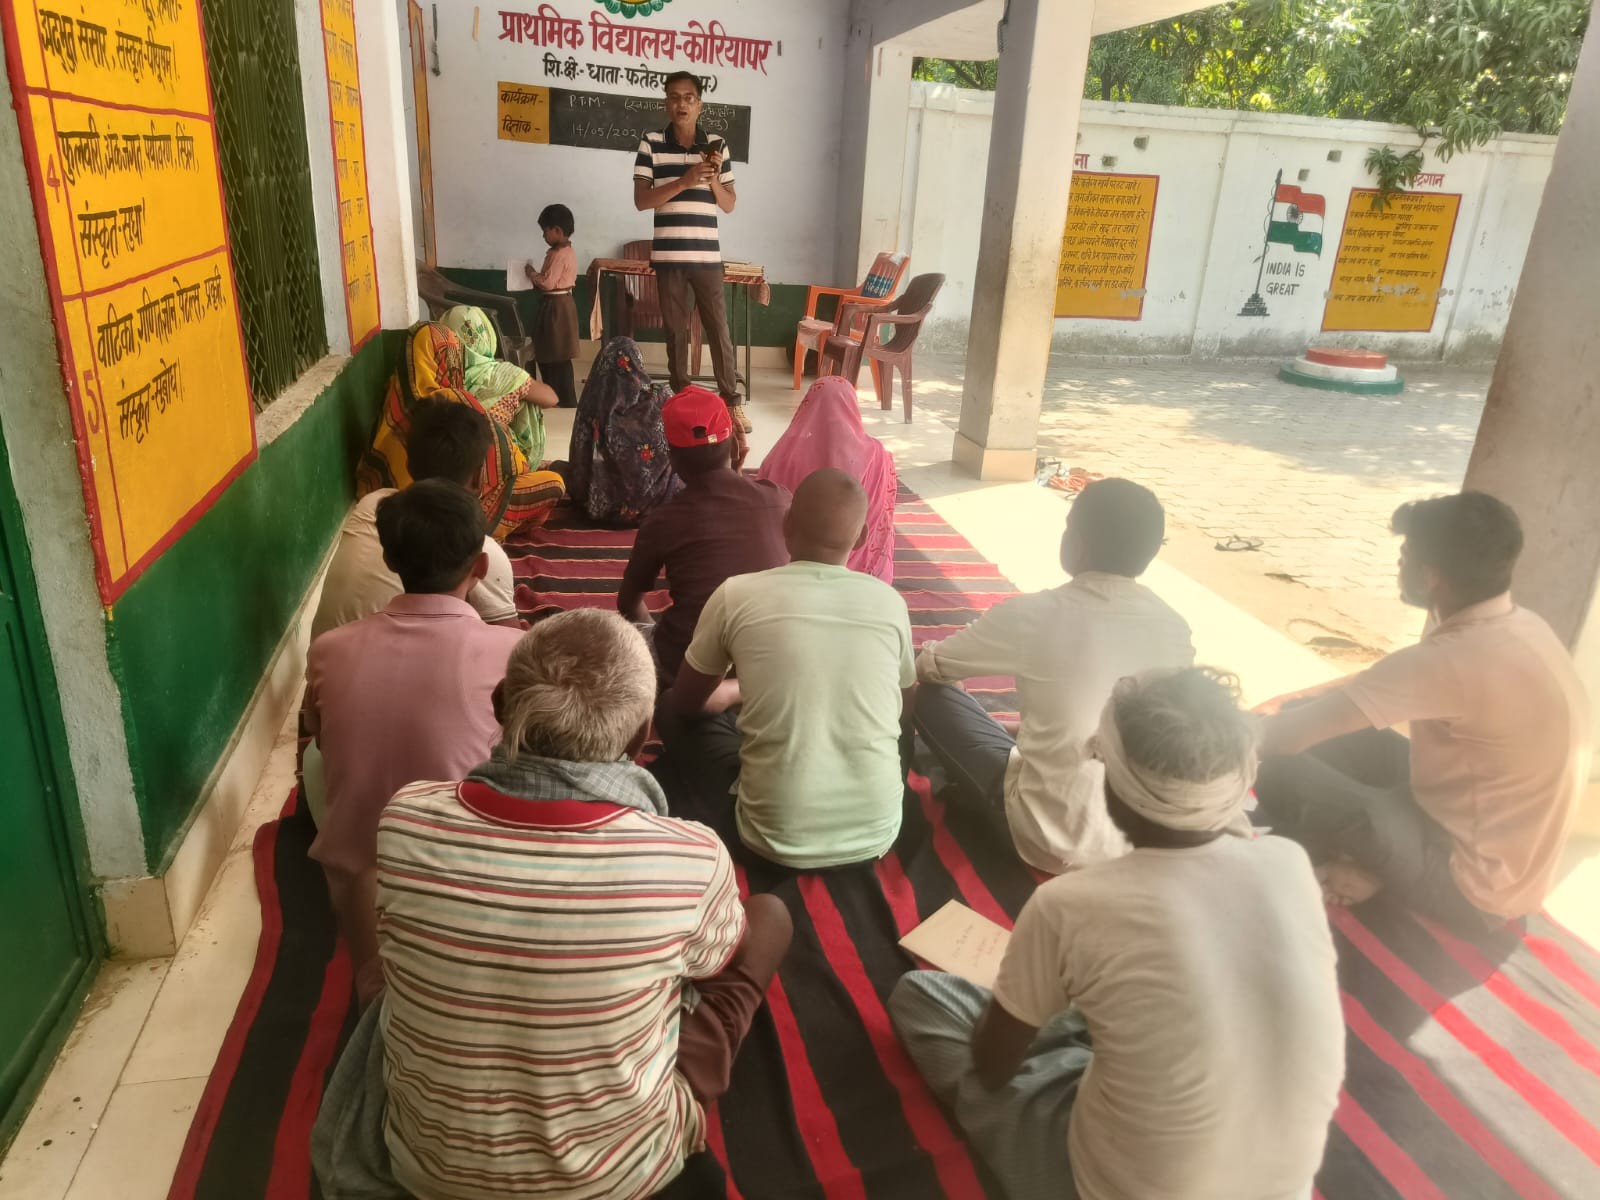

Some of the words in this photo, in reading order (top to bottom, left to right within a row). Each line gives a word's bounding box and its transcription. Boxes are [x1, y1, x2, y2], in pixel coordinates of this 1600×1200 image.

[498, 4, 584, 50] प्राथमिक
[47, 154, 61, 203] 4
[1265, 261, 1291, 276] INDIA
[1295, 261, 1306, 278] IS
[1265, 282, 1300, 296] GREAT
[83, 369, 99, 434] 5
